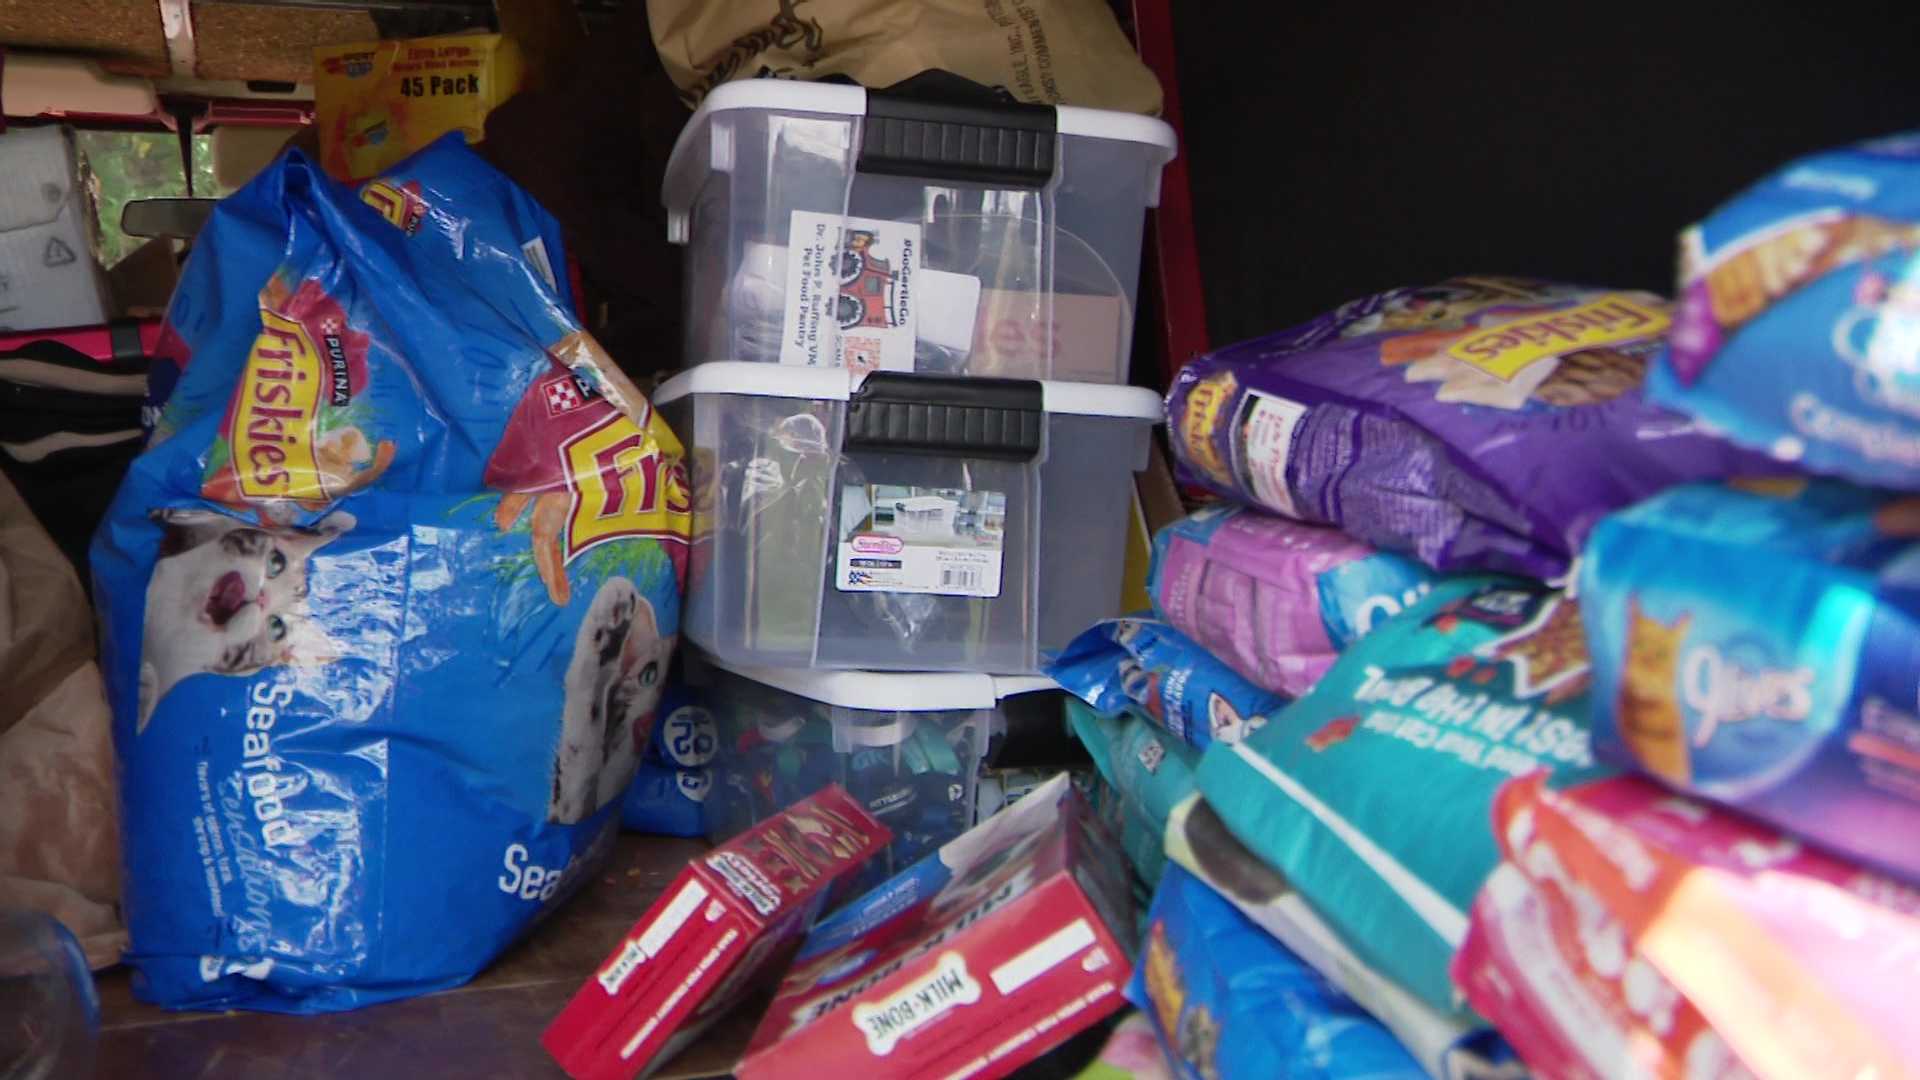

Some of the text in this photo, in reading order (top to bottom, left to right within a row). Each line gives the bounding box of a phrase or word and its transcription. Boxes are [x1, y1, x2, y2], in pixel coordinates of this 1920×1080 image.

[401, 74, 479, 97] 45 Pack
[800, 270, 811, 302] Food
[802, 247, 813, 267] Pet
[1462, 302, 1652, 362] Friskies
[325, 336, 350, 404] PURINA
[247, 325, 308, 486] Friskies
[242, 680, 294, 851] Seafood
